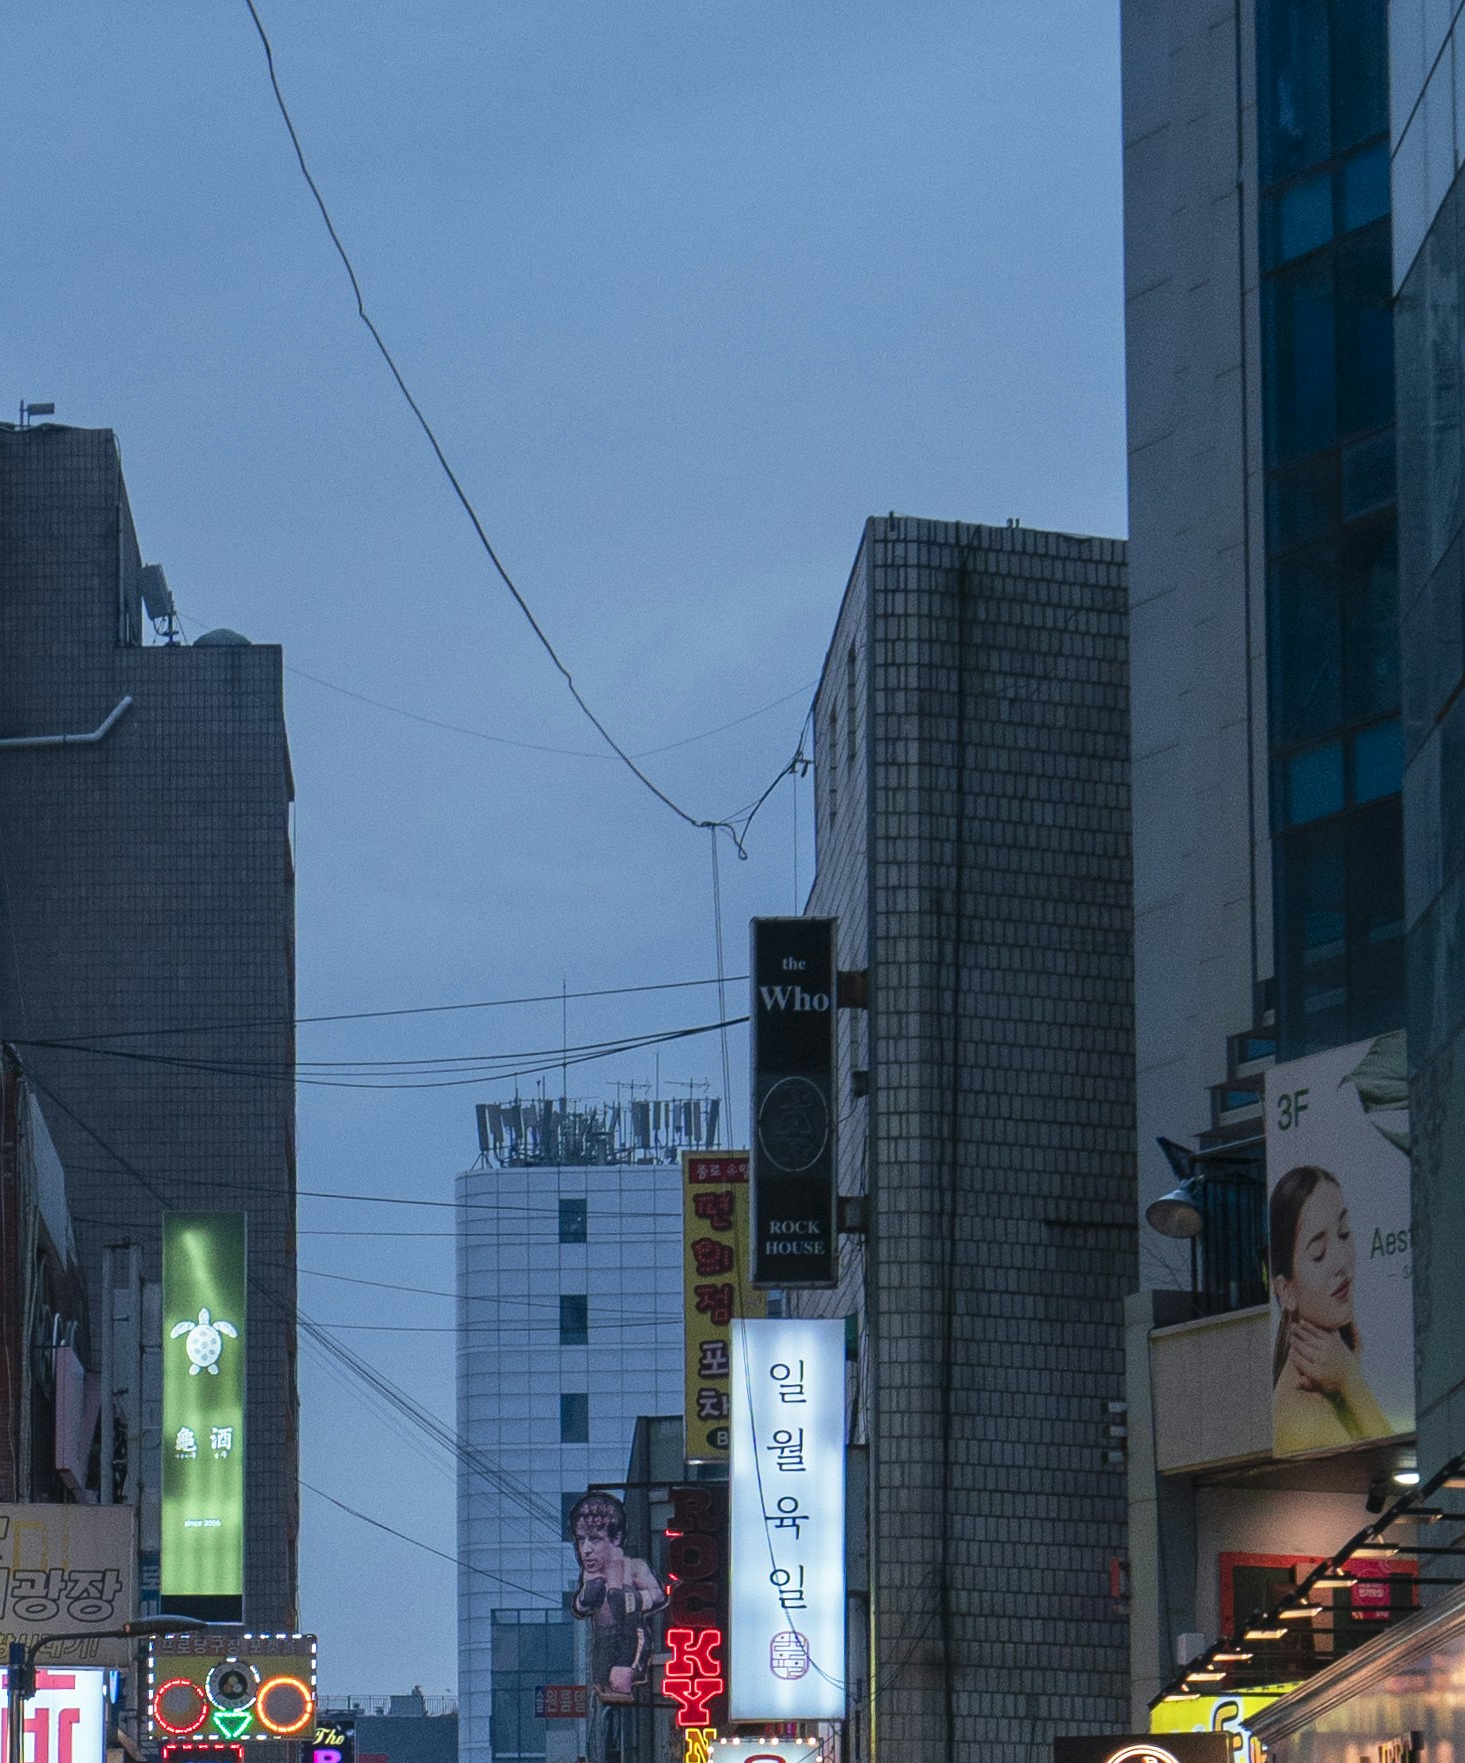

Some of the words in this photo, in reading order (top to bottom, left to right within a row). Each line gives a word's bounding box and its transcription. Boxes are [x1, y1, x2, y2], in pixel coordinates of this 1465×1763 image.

[782, 957, 806, 971] the
[759, 985, 830, 1012] Who
[1277, 1088, 1310, 1132] 3F
[769, 1219, 821, 1234] ROCK
[765, 1241, 826, 1256] HOUSE
[765, 1360, 811, 1611] 일월육일
[312, 1727, 344, 1745] The
